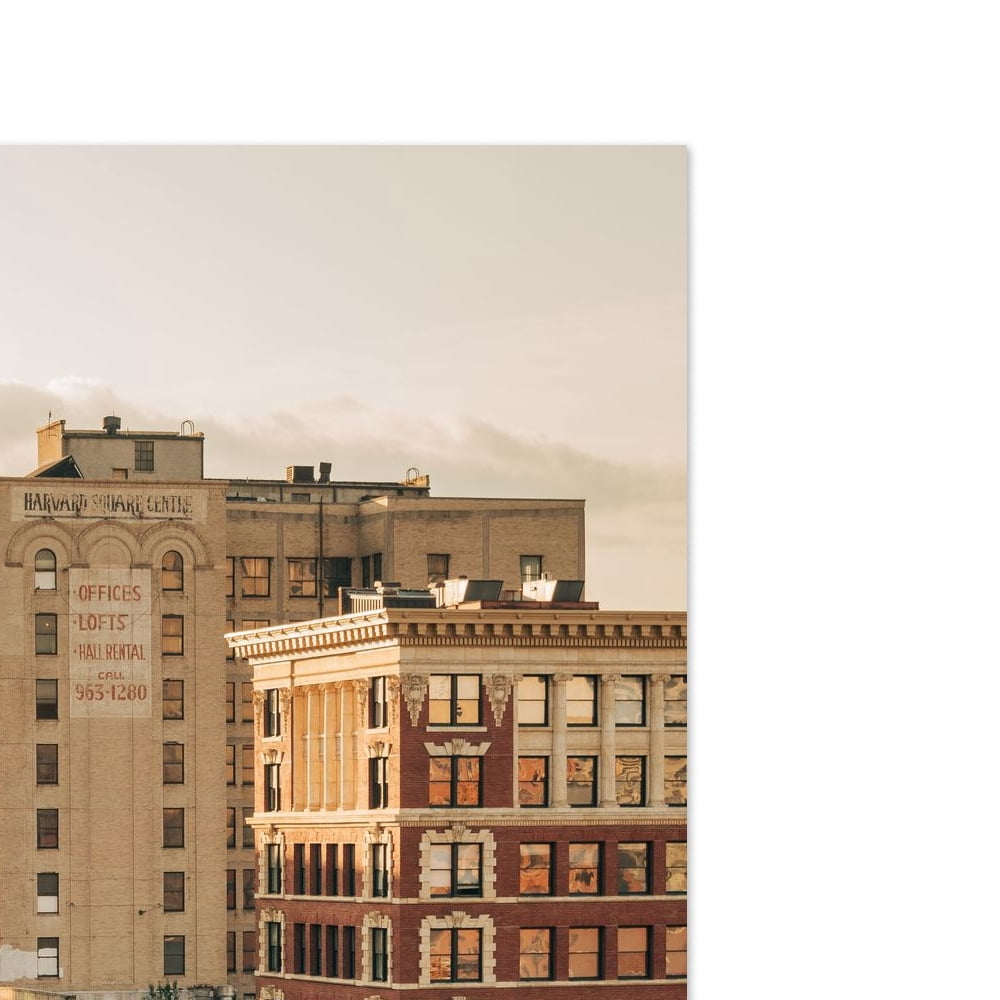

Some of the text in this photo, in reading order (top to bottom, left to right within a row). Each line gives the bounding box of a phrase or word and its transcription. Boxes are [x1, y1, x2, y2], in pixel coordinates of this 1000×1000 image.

[24, 493, 88, 513] HARVARD
[79, 584, 142, 602] OFFICES
[79, 613, 127, 631] LOFTS
[79, 643, 146, 660] HALL RENTAL
[98, 671, 125, 680] CALL
[75, 683, 148, 701] 963-1280
